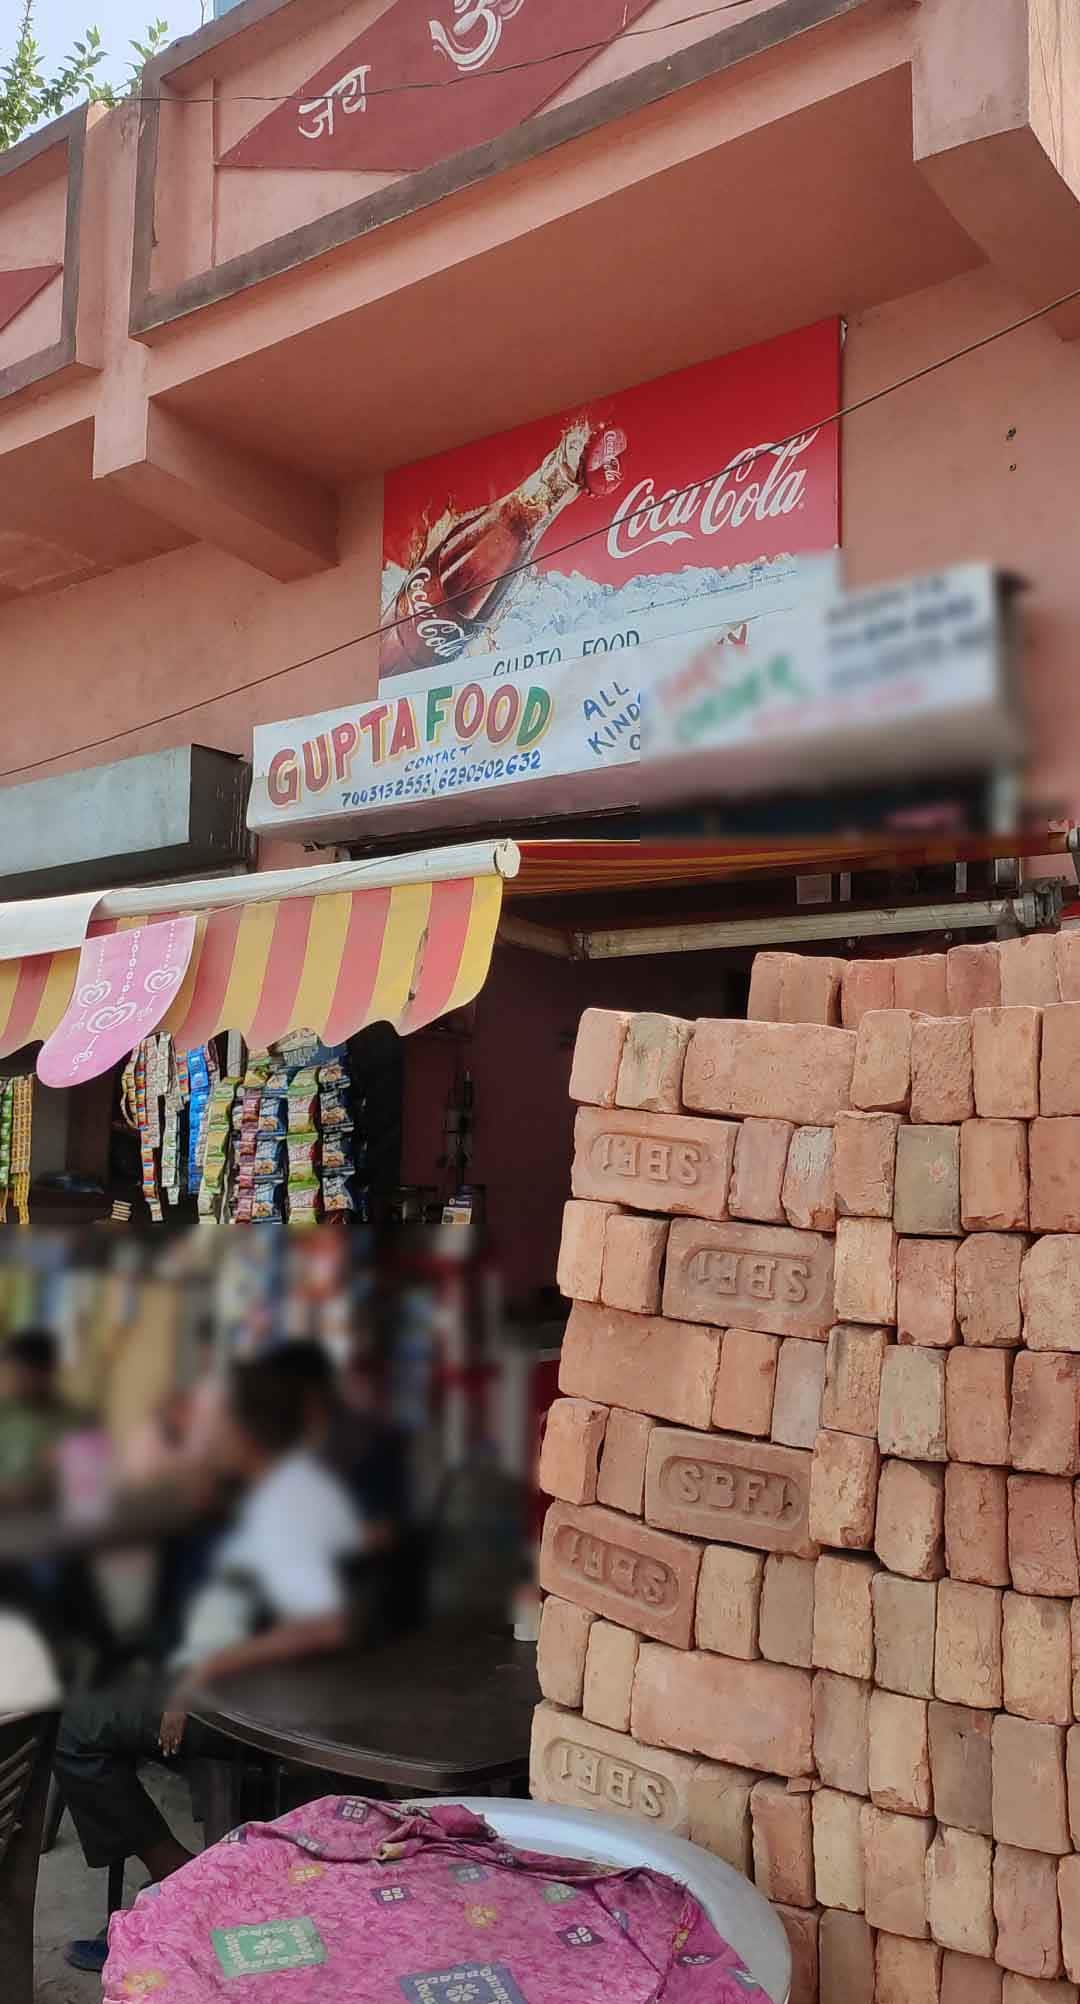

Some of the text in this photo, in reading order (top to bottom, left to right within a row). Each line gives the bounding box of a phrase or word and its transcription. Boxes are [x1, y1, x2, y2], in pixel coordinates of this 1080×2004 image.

[607, 427, 820, 560] Coca-Cola
[583, 681, 630, 721] ALL
[588, 692, 640, 755] KIND
[267, 682, 554, 806] GUPTA FOOD
[403, 744, 473, 773] CONTACT
